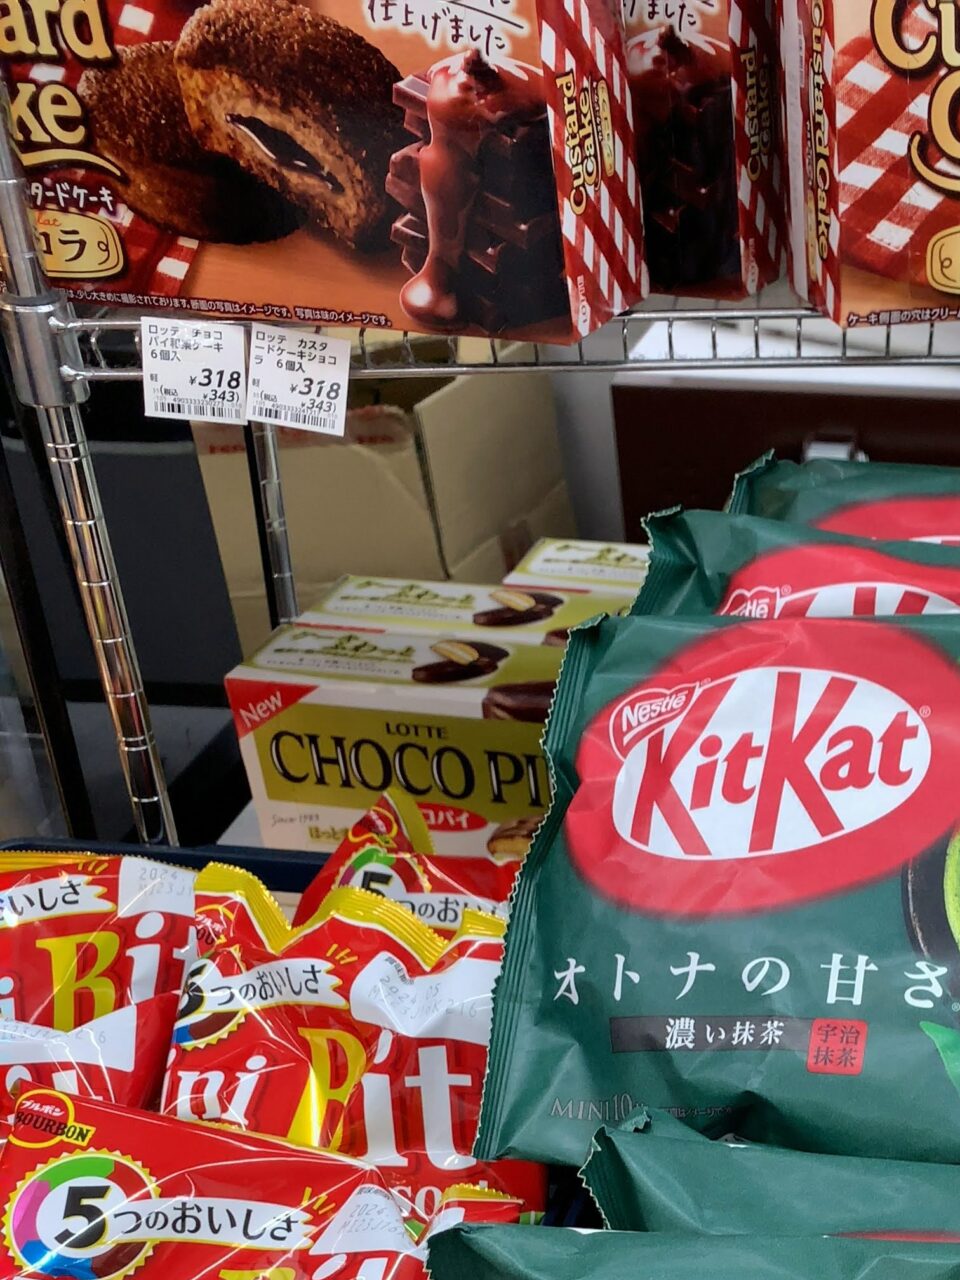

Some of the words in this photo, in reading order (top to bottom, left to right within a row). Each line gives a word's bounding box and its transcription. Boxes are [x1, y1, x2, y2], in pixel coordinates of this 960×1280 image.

[556, 71, 586, 216] Custard
[578, 86, 599, 185] Cake
[148, 324, 179, 336] ロッテ
[192, 328, 223, 340] チョコ
[256, 331, 287, 344] ロッテ
[298, 338, 328, 352] カスタ
[189, 367, 241, 390] ¥318
[290, 377, 341, 401] ¥318
[203, 388, 240, 403] ¥343)
[301, 398, 337, 414] ¥343)
[239, 691, 283, 728] New
[386, 722, 447, 739] LOTTE
[271, 730, 475, 800] CHOCO
[484, 750, 552, 807] PI
[630, 671, 920, 857] KitKat
[553, 951, 949, 1010] オトナの甘さ
[665, 1016, 786, 1050] 濃い抹茶
[817, 1023, 861, 1044] 宇治
[813, 1046, 859, 1068] 抹茶
[14, 1110, 91, 1143] BOURBON
